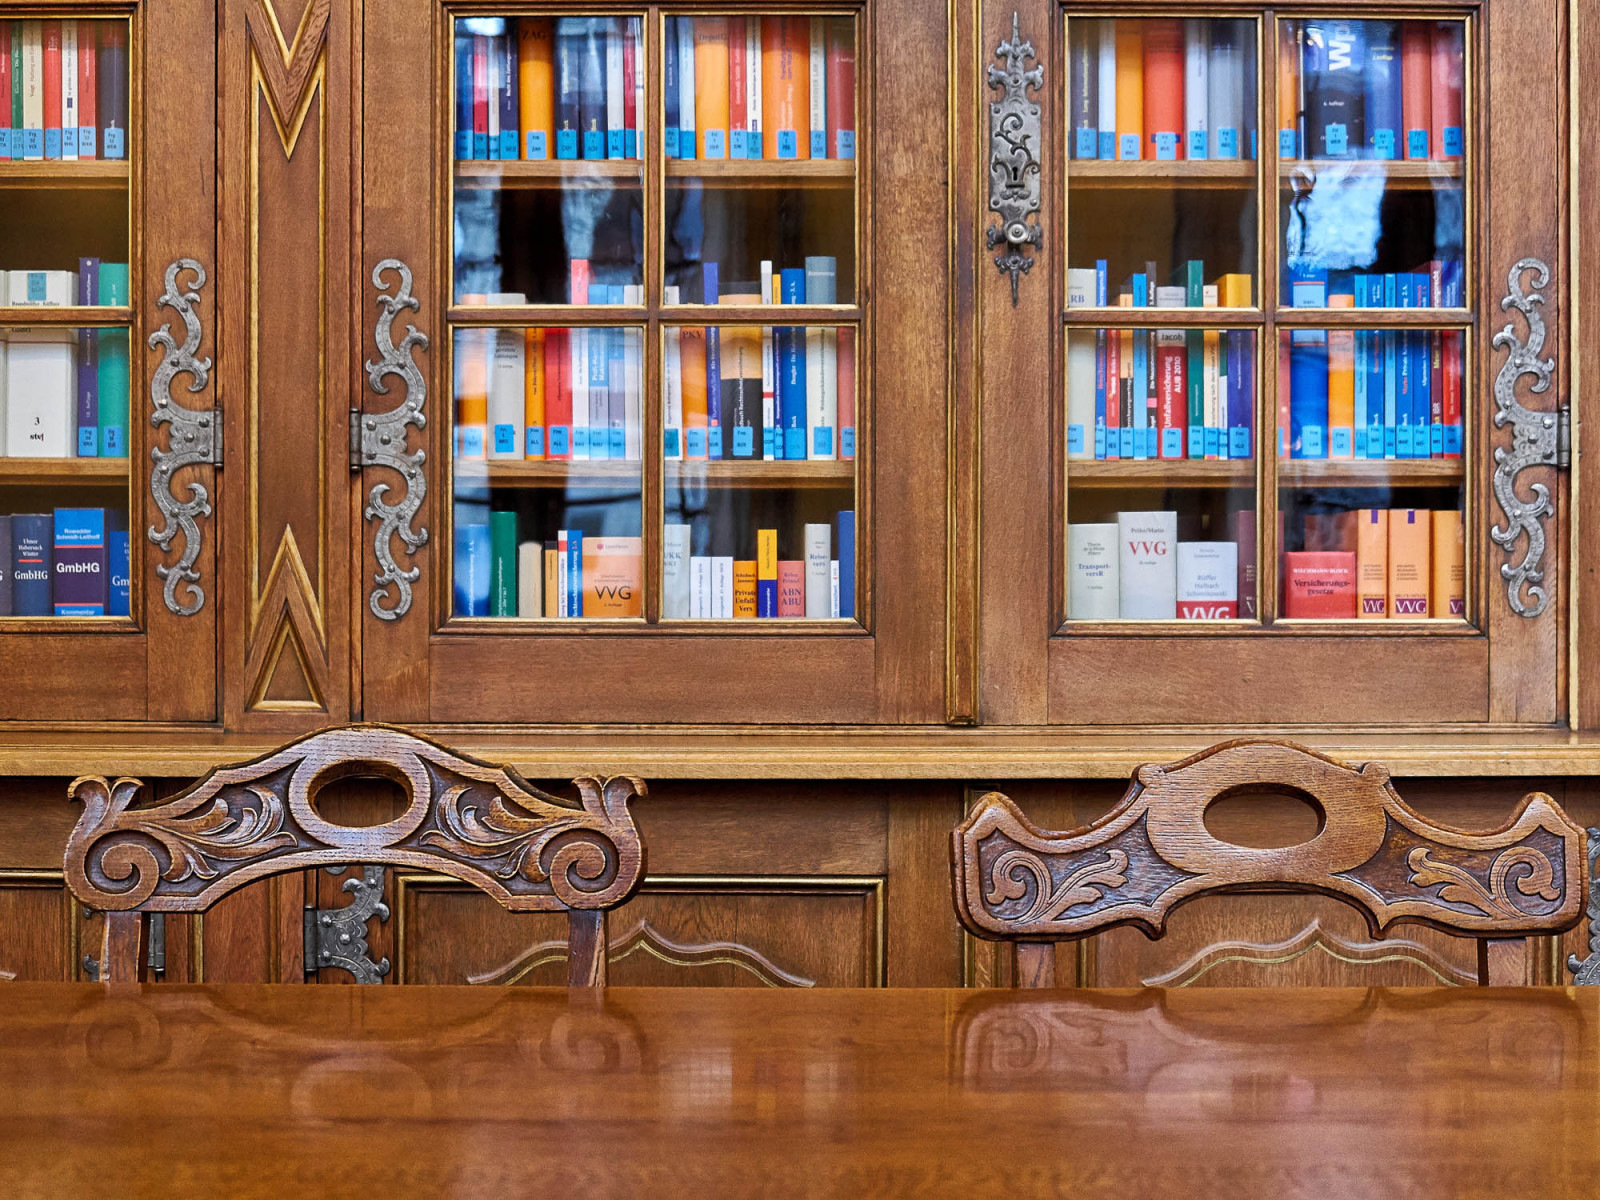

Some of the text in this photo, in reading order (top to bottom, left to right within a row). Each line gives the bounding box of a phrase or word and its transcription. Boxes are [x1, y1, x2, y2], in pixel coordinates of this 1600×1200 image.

[1164, 356, 1173, 428] Unfallversicherung
[34, 416, 40, 426] 3
[1128, 541, 1167, 555] VVG
[56, 562, 100, 573] GmbHG
[14, 570, 48, 580] GmbHG
[595, 585, 631, 600] VVG
[1183, 606, 1230, 619] VVG
[1363, 600, 1384, 612] VVG
[1395, 600, 1426, 613] VVG
